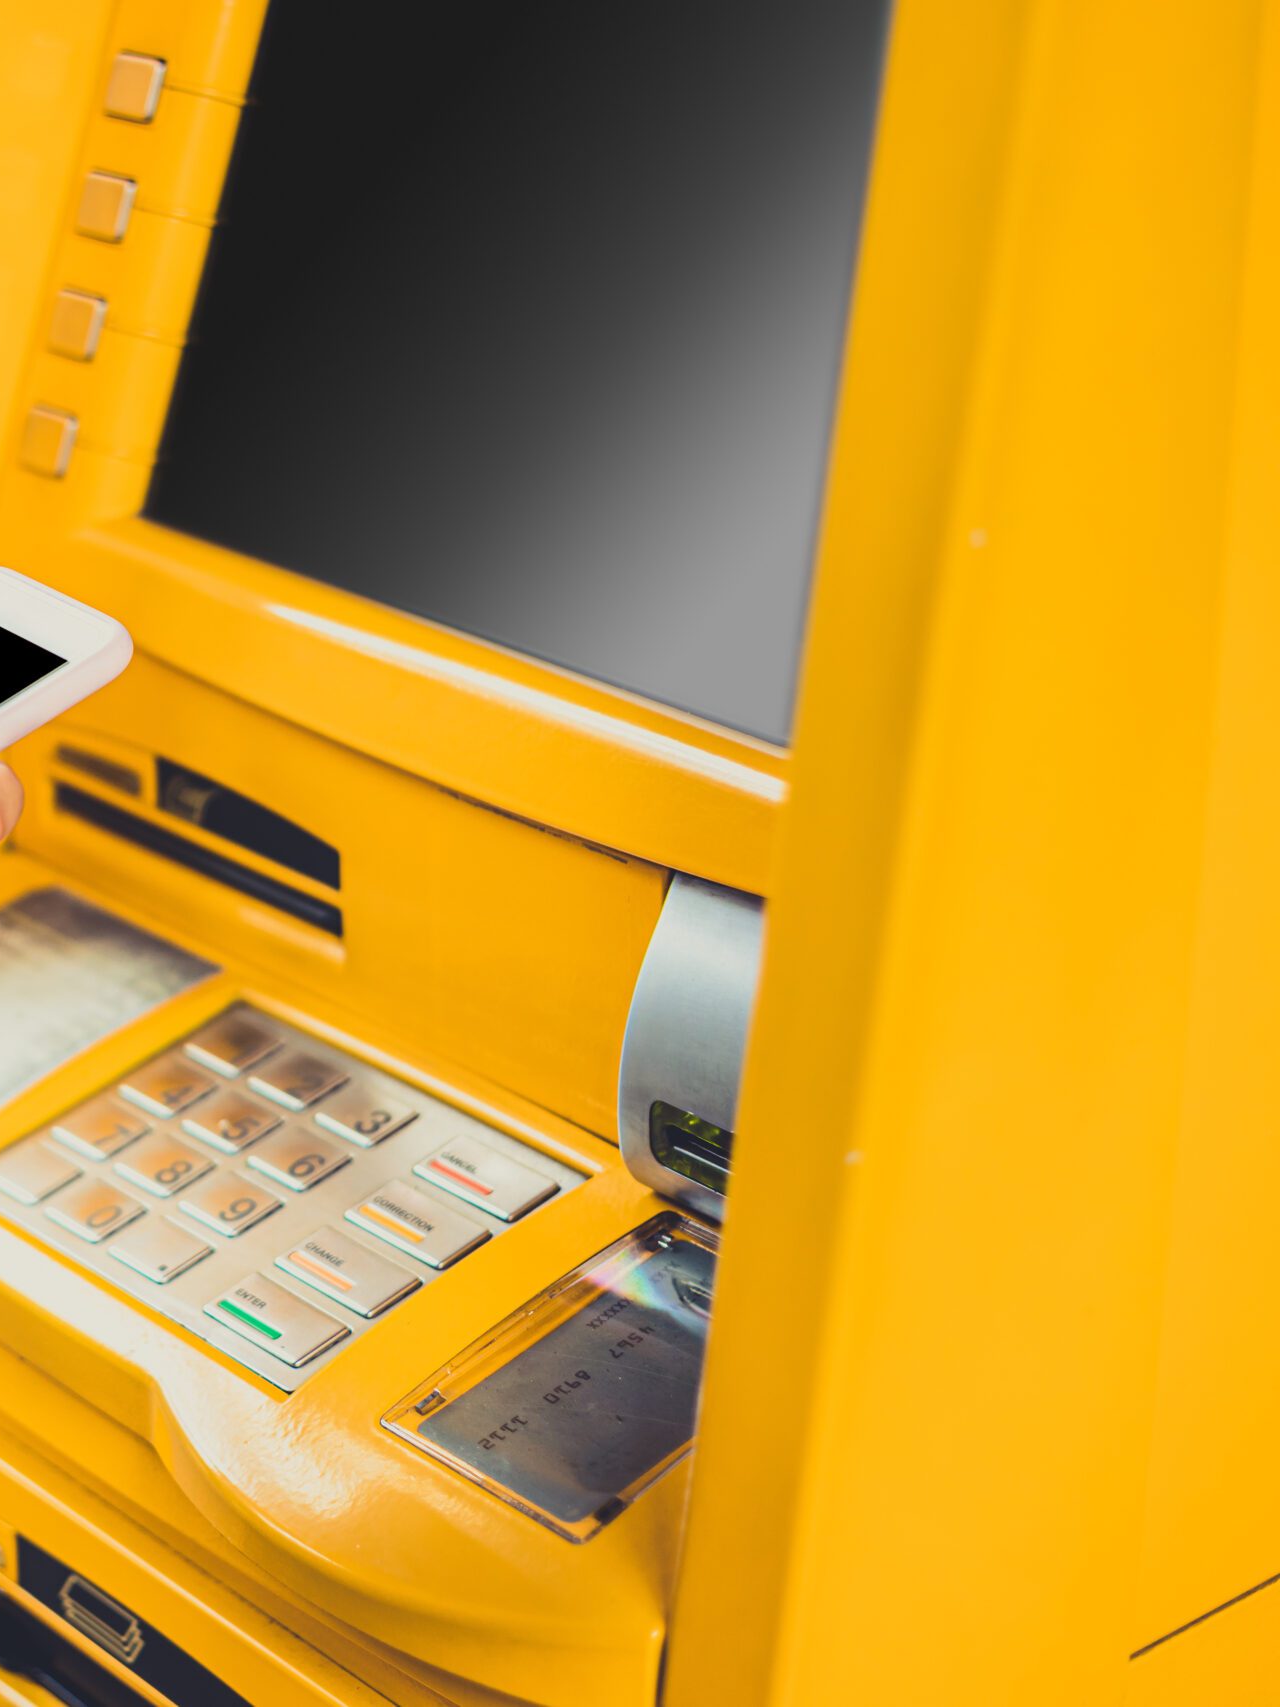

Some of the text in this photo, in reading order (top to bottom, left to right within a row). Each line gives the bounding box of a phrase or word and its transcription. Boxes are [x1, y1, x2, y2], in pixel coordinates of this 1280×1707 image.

[222, 1116, 260, 1141] 5
[353, 1110, 392, 1134] 3
[154, 1160, 193, 1185] 8
[288, 1154, 326, 1178] 6
[440, 1151, 478, 1174] CANCEL
[86, 1205, 123, 1229] 0
[219, 1197, 258, 1222] 9
[373, 1195, 436, 1232] CORRECTION
[304, 1241, 346, 1268] CHANGE
[234, 1288, 268, 1310] ENTER
[477, 1326, 656, 1451] 4567 8910 1112
